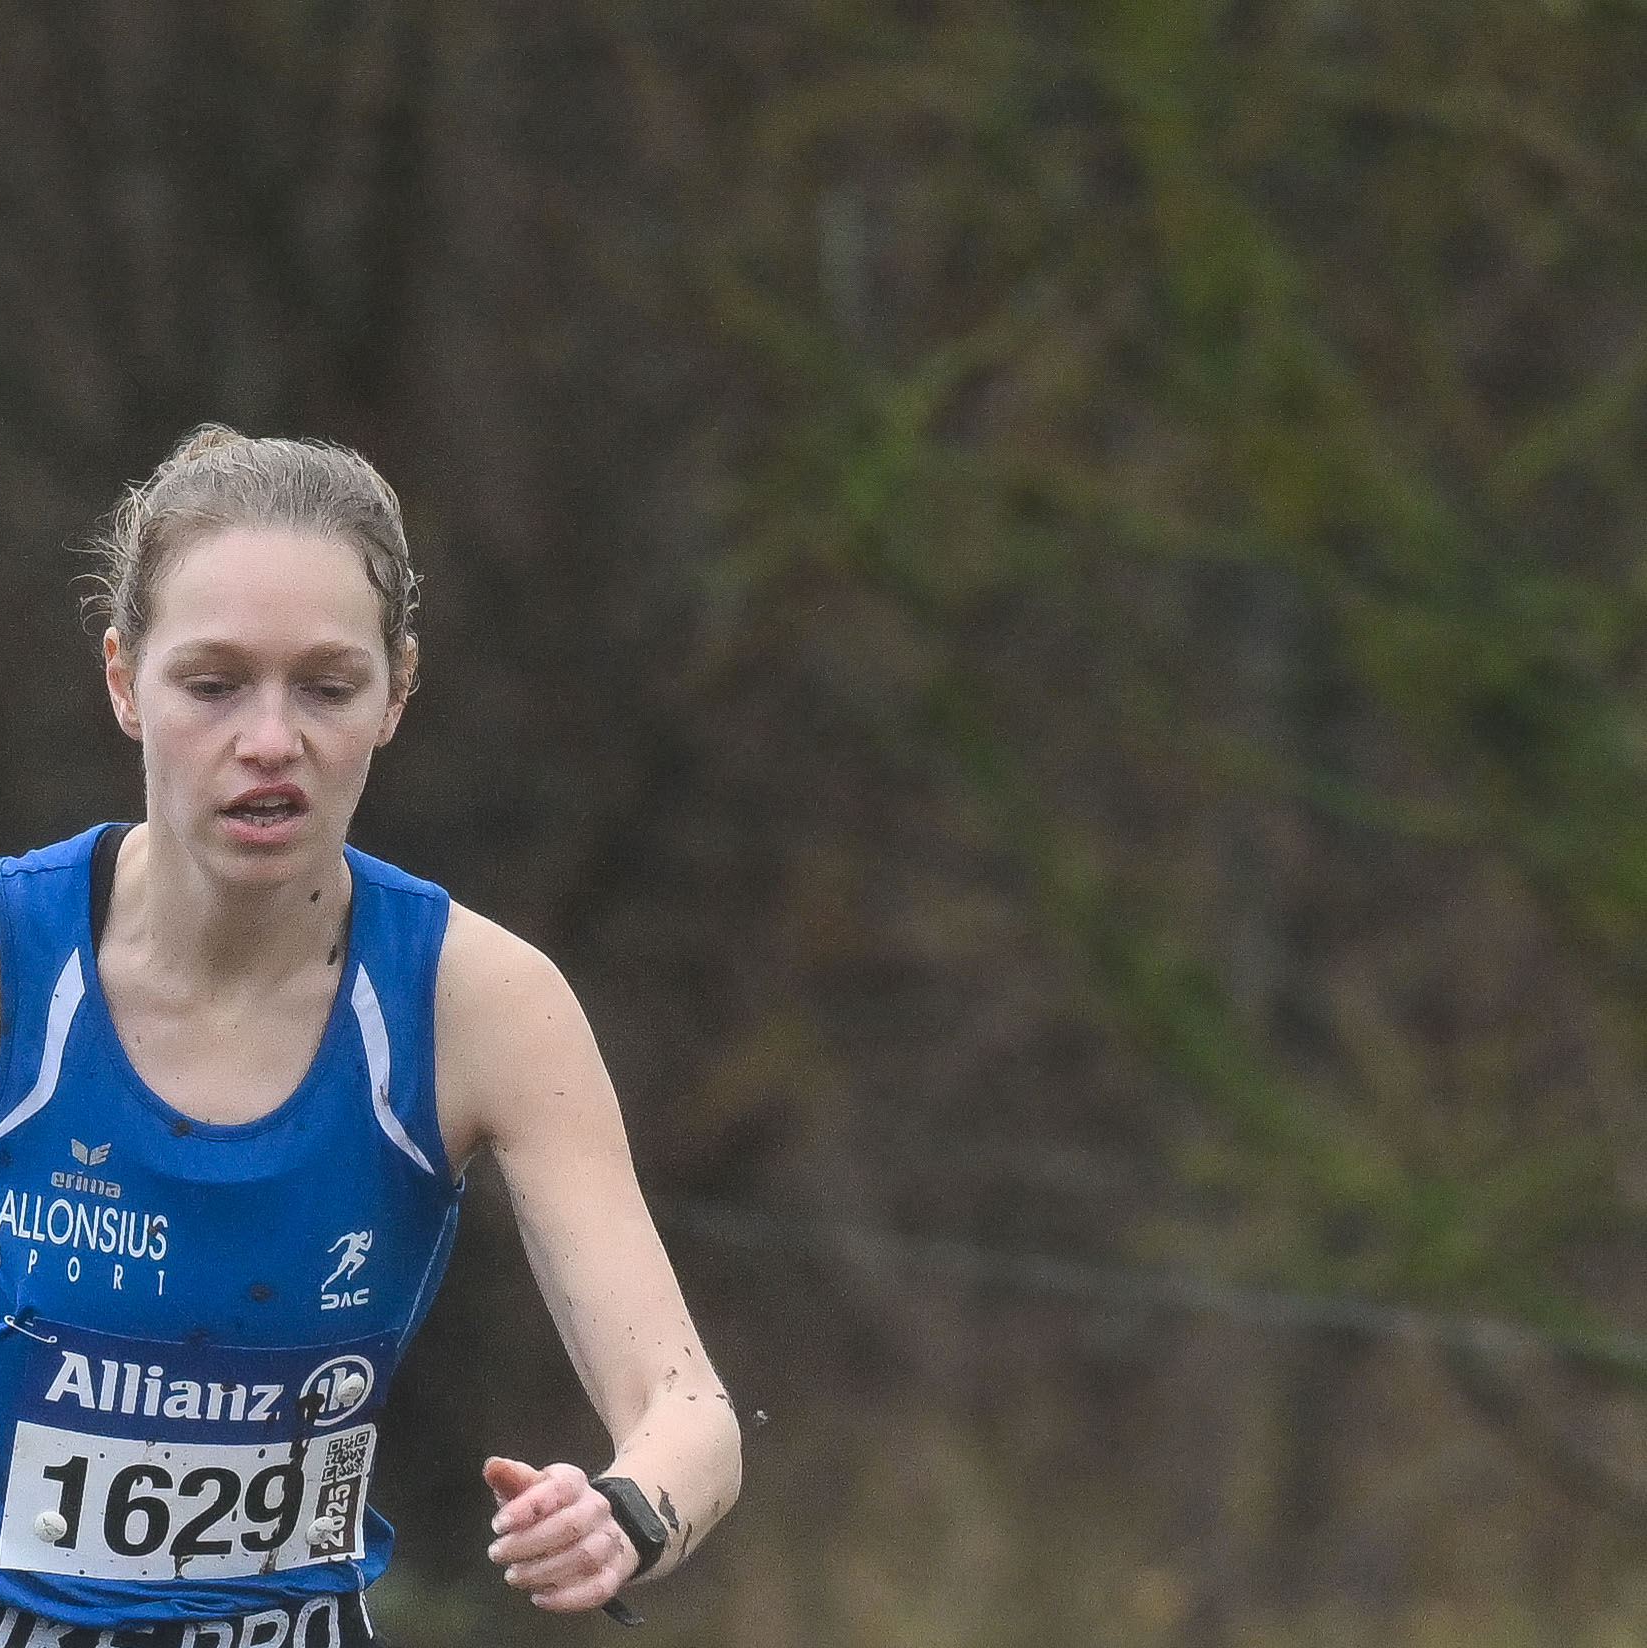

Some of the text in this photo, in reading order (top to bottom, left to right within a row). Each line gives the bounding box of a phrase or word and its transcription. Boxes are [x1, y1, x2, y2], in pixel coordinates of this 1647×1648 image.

[50, 1170, 122, 1199] erima
[45, 1350, 284, 1422] Allianz
[42, 1454, 305, 1557] 1629
[321, 1483, 351, 1551] 2025
